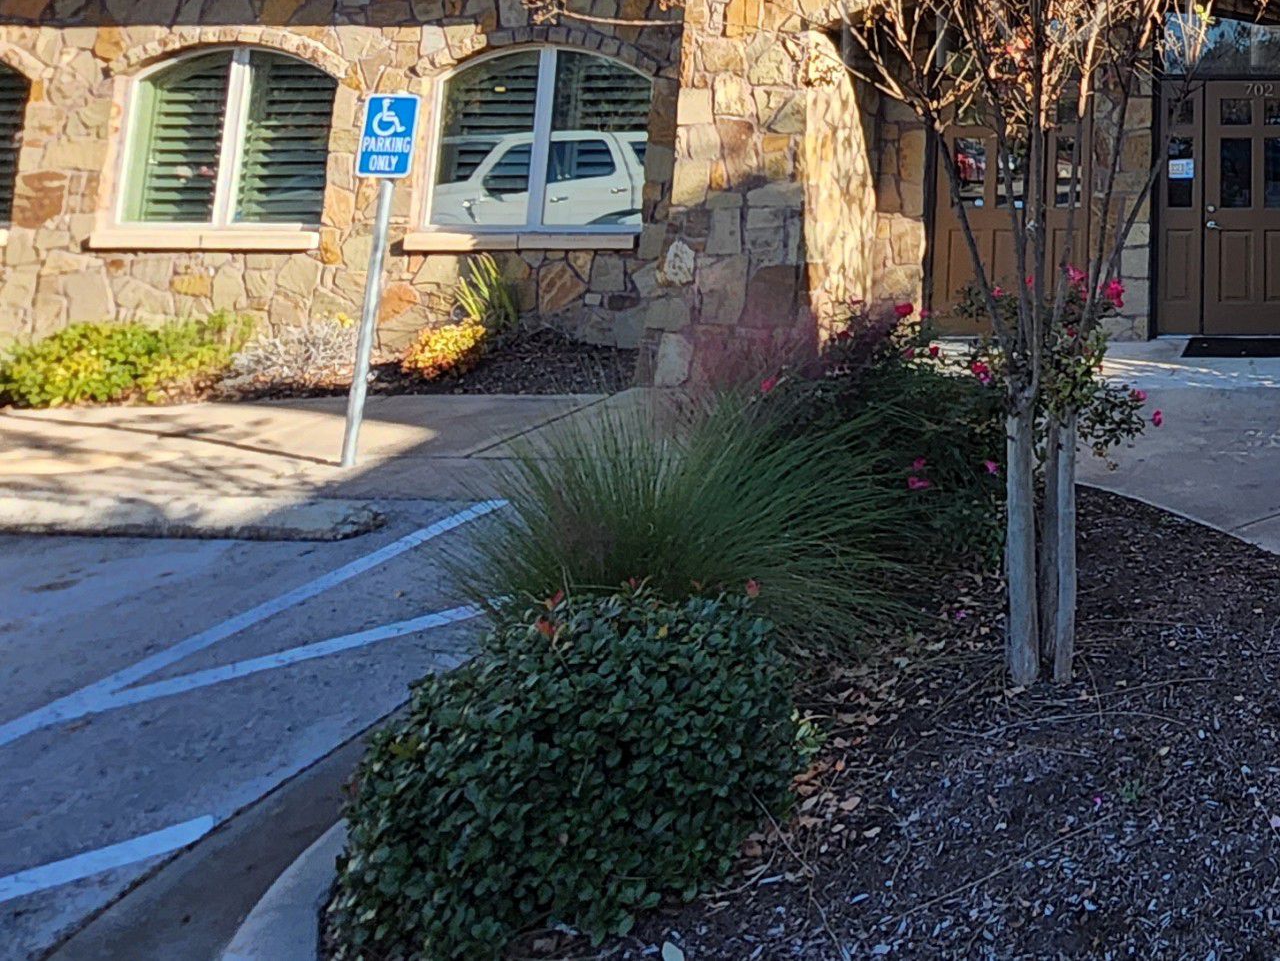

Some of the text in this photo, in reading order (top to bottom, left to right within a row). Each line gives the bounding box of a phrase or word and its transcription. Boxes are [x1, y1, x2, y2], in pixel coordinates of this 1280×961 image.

[1245, 83, 1274, 97] 702
[362, 136, 412, 153] PARKING
[368, 154, 398, 171] ONLY
